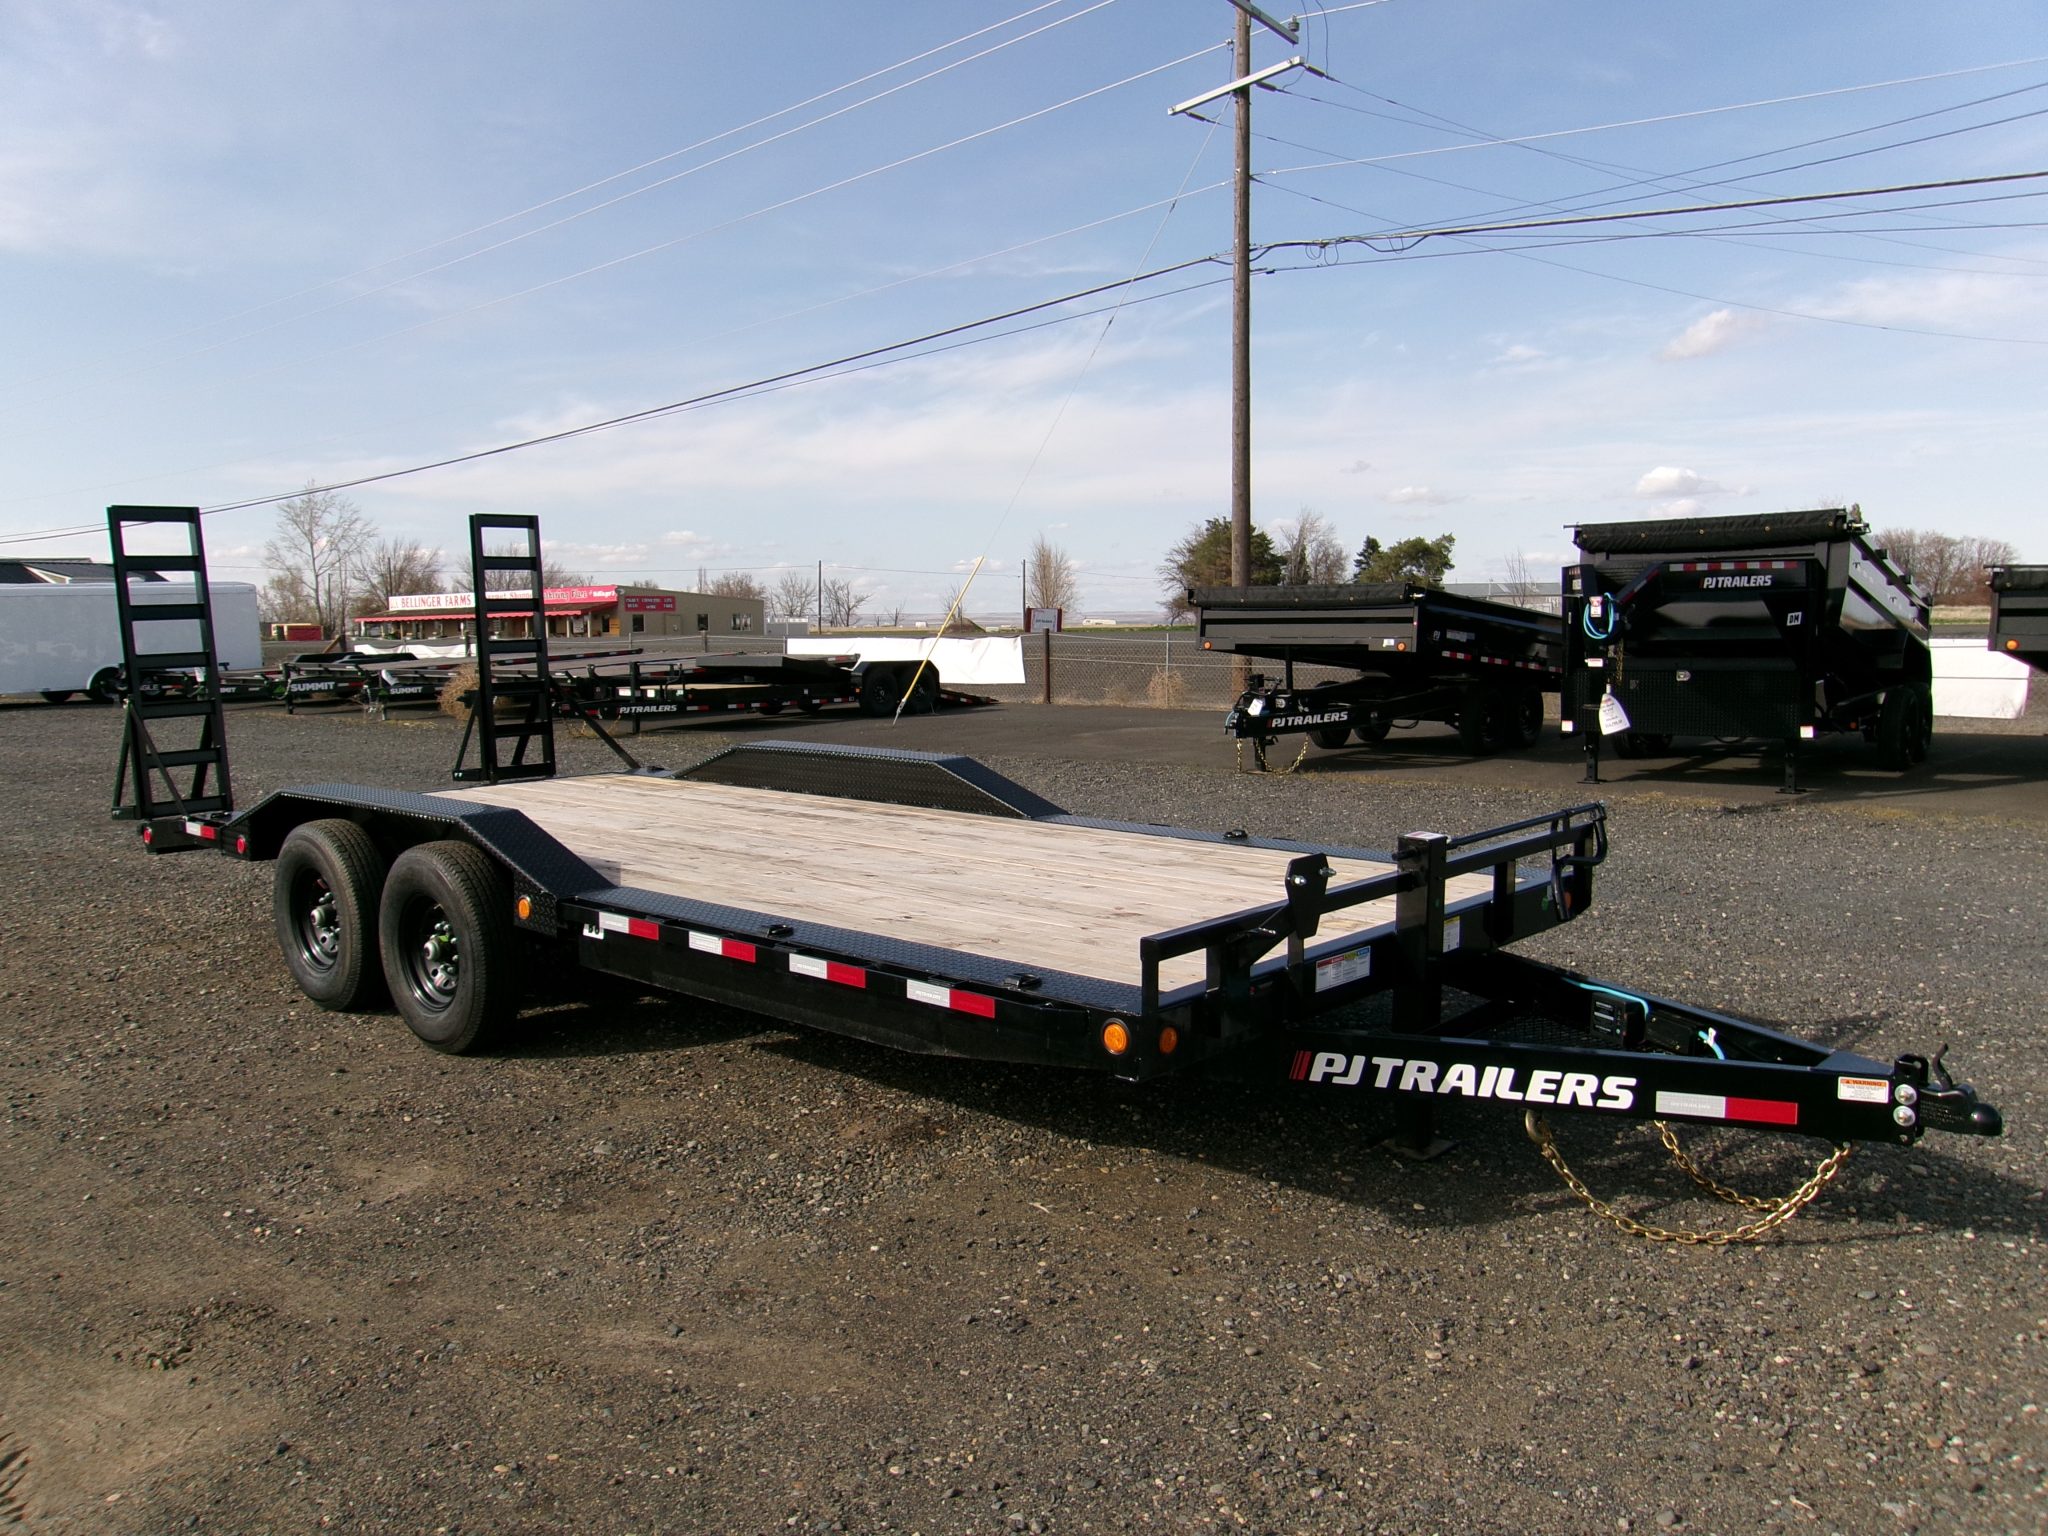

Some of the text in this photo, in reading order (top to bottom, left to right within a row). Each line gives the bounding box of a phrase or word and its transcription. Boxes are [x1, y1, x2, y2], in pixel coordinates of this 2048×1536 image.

[1703, 575, 1772, 588] PJ TRAILERS
[401, 597, 440, 608] BELLINGER
[445, 595, 472, 606] FARMS
[291, 681, 335, 692] SUMMIT
[390, 687, 423, 695] SUMMIT
[630, 705, 677, 713] TRAILERS
[1272, 712, 1348, 728] PJ TRAILERS
[1309, 1052, 1637, 1110] PJ TRAILERS
